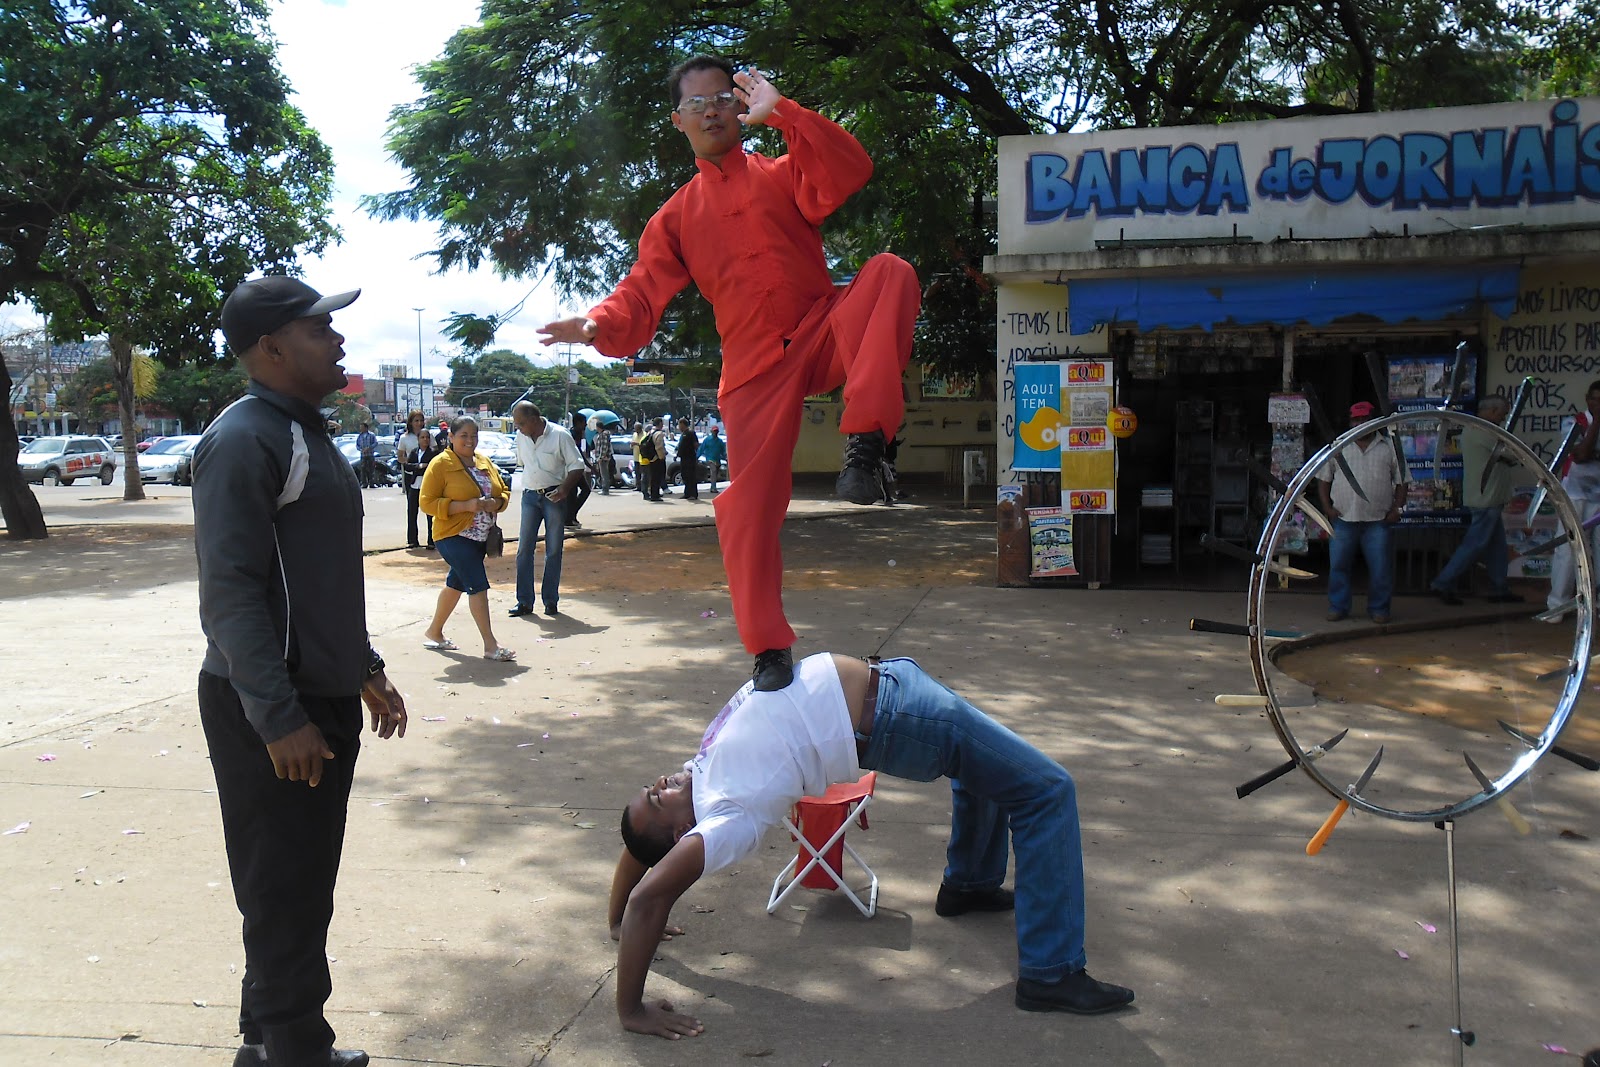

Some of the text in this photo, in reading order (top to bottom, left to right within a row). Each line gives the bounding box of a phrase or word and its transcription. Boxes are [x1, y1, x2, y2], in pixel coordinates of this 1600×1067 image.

[1026, 142, 1249, 224] BANCA
[1257, 147, 1316, 201] de
[1513, 287, 1544, 315] MOS
[1007, 311, 1050, 335] TEMOS
[1068, 364, 1104, 382] aQui
[1022, 384, 1054, 395] AQUI
[1022, 399, 1046, 409] TEM
[1069, 429, 1105, 445] aQui
[1071, 493, 1106, 508] aQui
